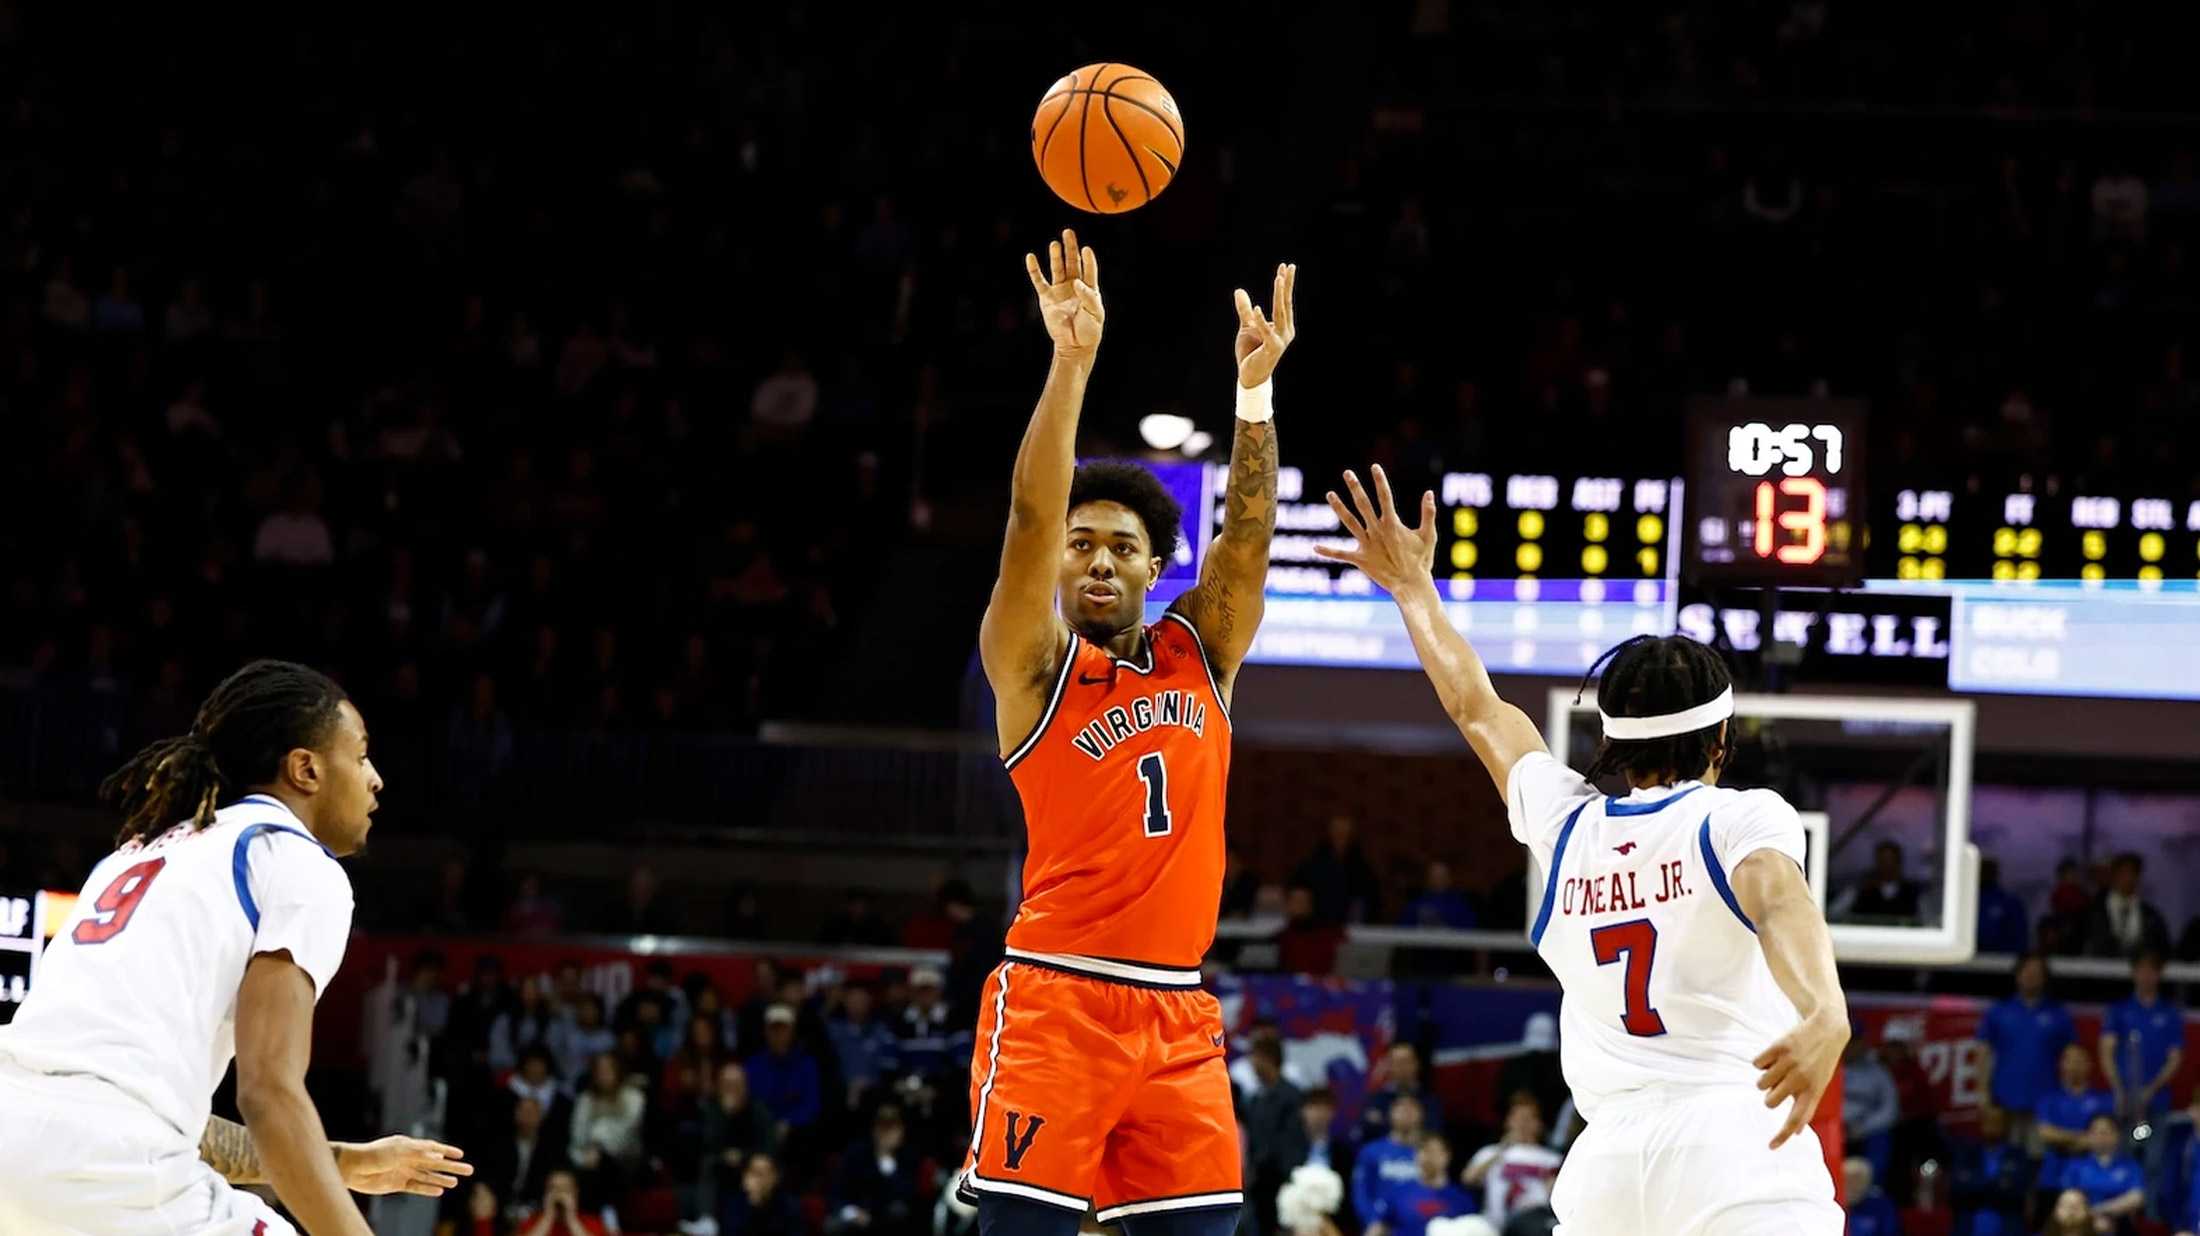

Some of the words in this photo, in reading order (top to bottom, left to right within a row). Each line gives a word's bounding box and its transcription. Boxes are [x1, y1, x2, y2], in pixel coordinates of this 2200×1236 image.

[1728, 422, 1844, 476] 10:57
[1755, 477, 1828, 564] 13
[1071, 690, 1206, 761] VIRGINIA
[1136, 751, 1172, 838] 1
[71, 856, 166, 945] 9
[1563, 872, 1646, 916] O'NEAL
[1655, 860, 1692, 902] JR.
[1590, 918, 1667, 1037] 7
[1002, 1109, 1048, 1172] V
